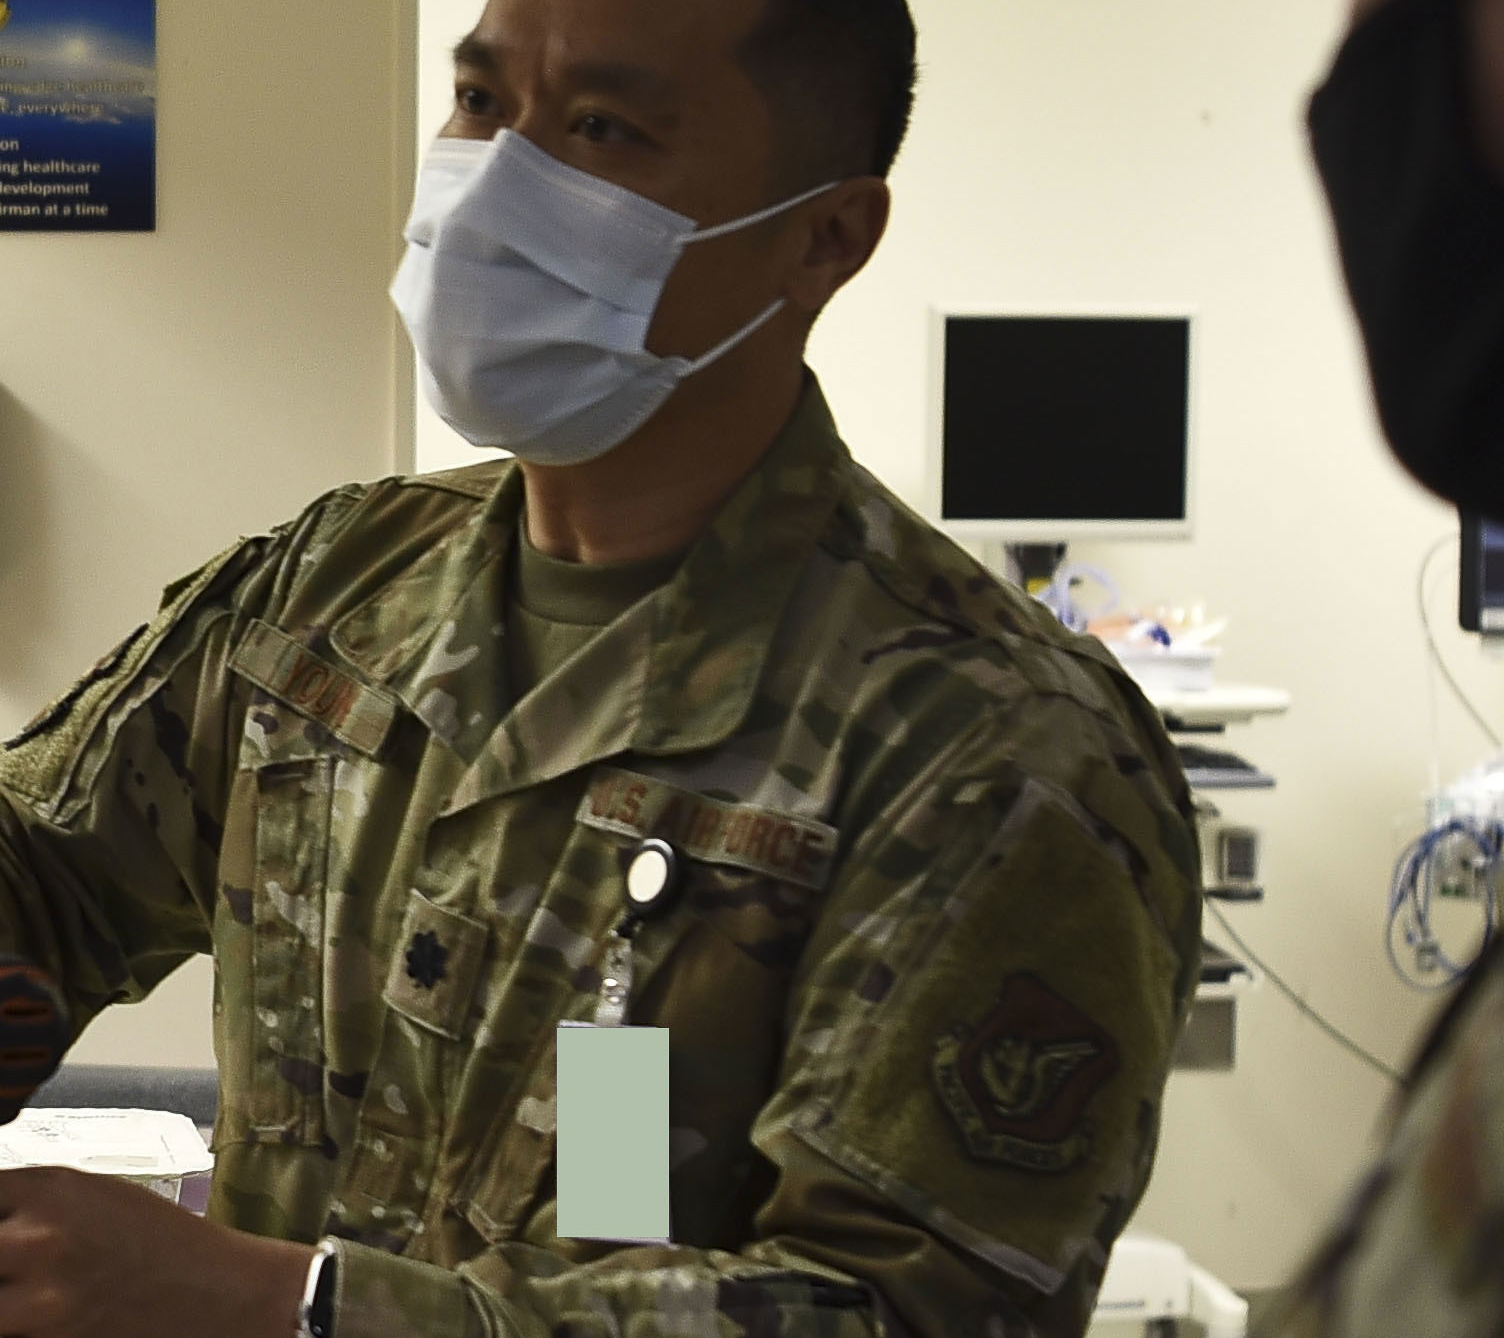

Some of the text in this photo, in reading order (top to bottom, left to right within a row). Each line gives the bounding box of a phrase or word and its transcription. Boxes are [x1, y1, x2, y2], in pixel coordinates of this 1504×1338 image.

[23, 160, 100, 173] healthcare
[45, 204, 58, 216] at
[63, 206, 71, 216] a
[75, 203, 109, 216] time
[722, 812, 826, 876] ORCE
